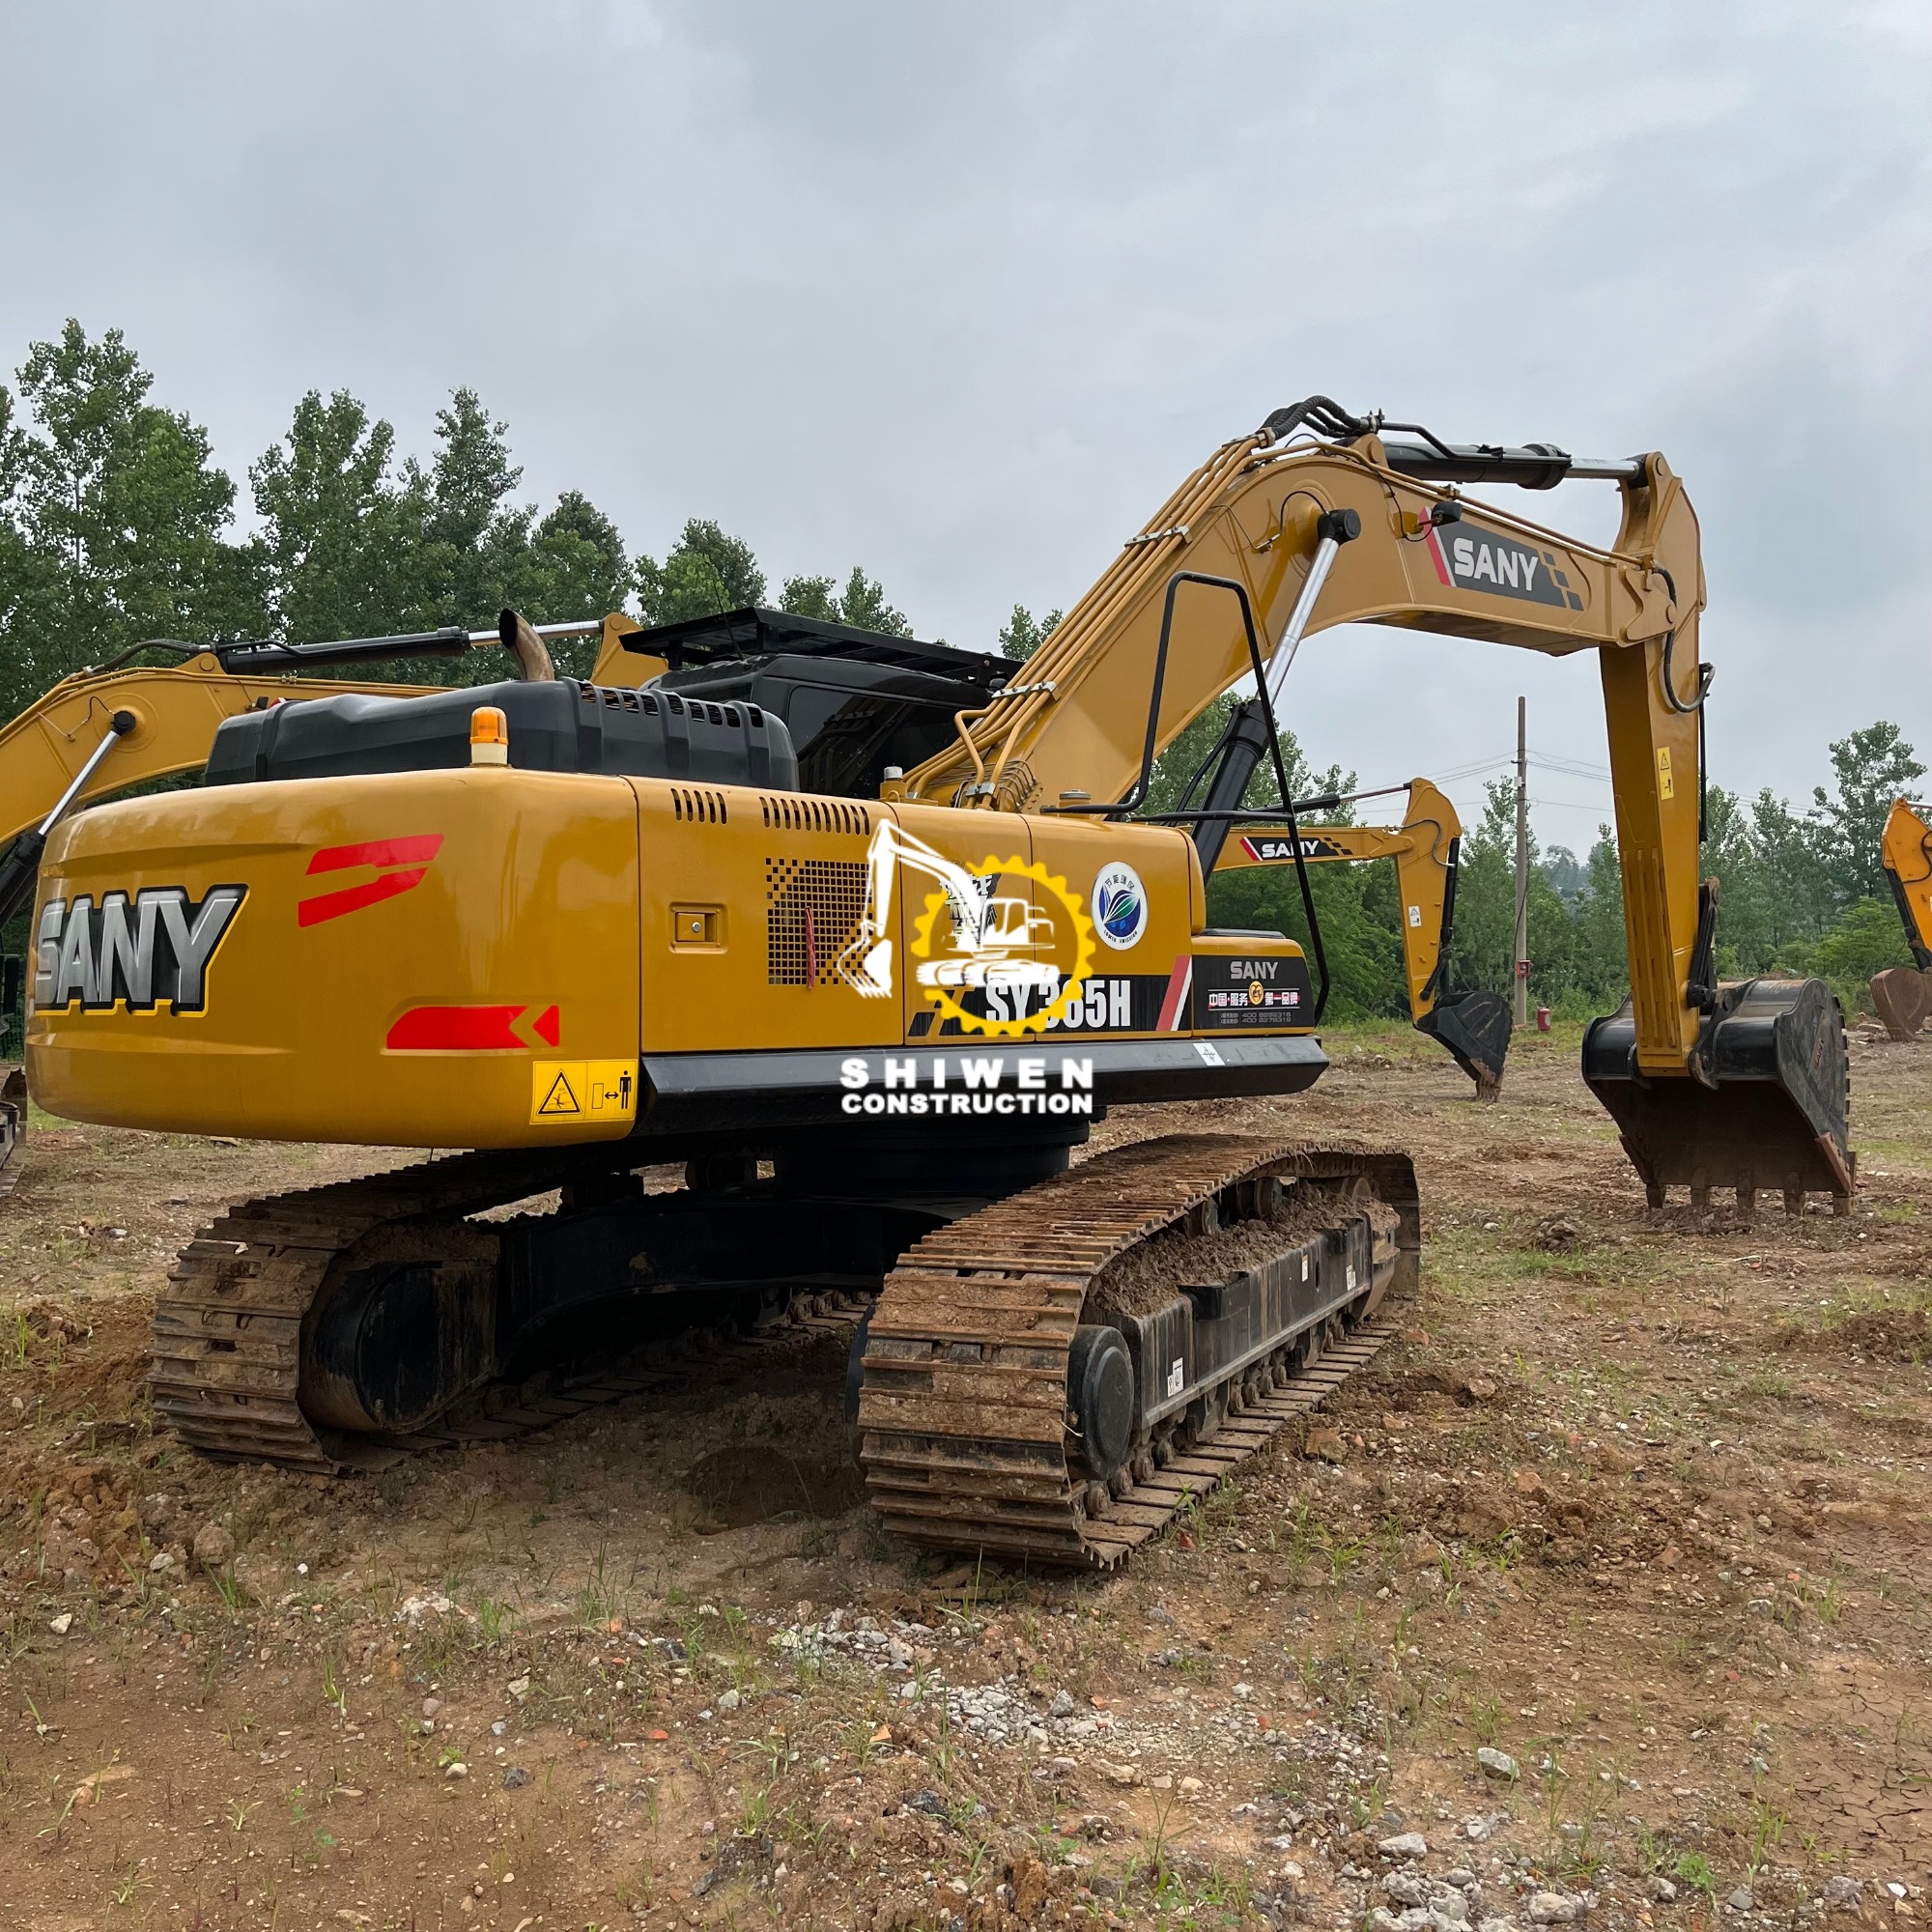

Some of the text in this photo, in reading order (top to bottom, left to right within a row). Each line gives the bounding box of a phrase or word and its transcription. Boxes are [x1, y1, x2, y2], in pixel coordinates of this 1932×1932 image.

[1453, 537, 1539, 591] SANY
[33, 887, 244, 1009] SANY
[1230, 960, 1278, 980] SANY
